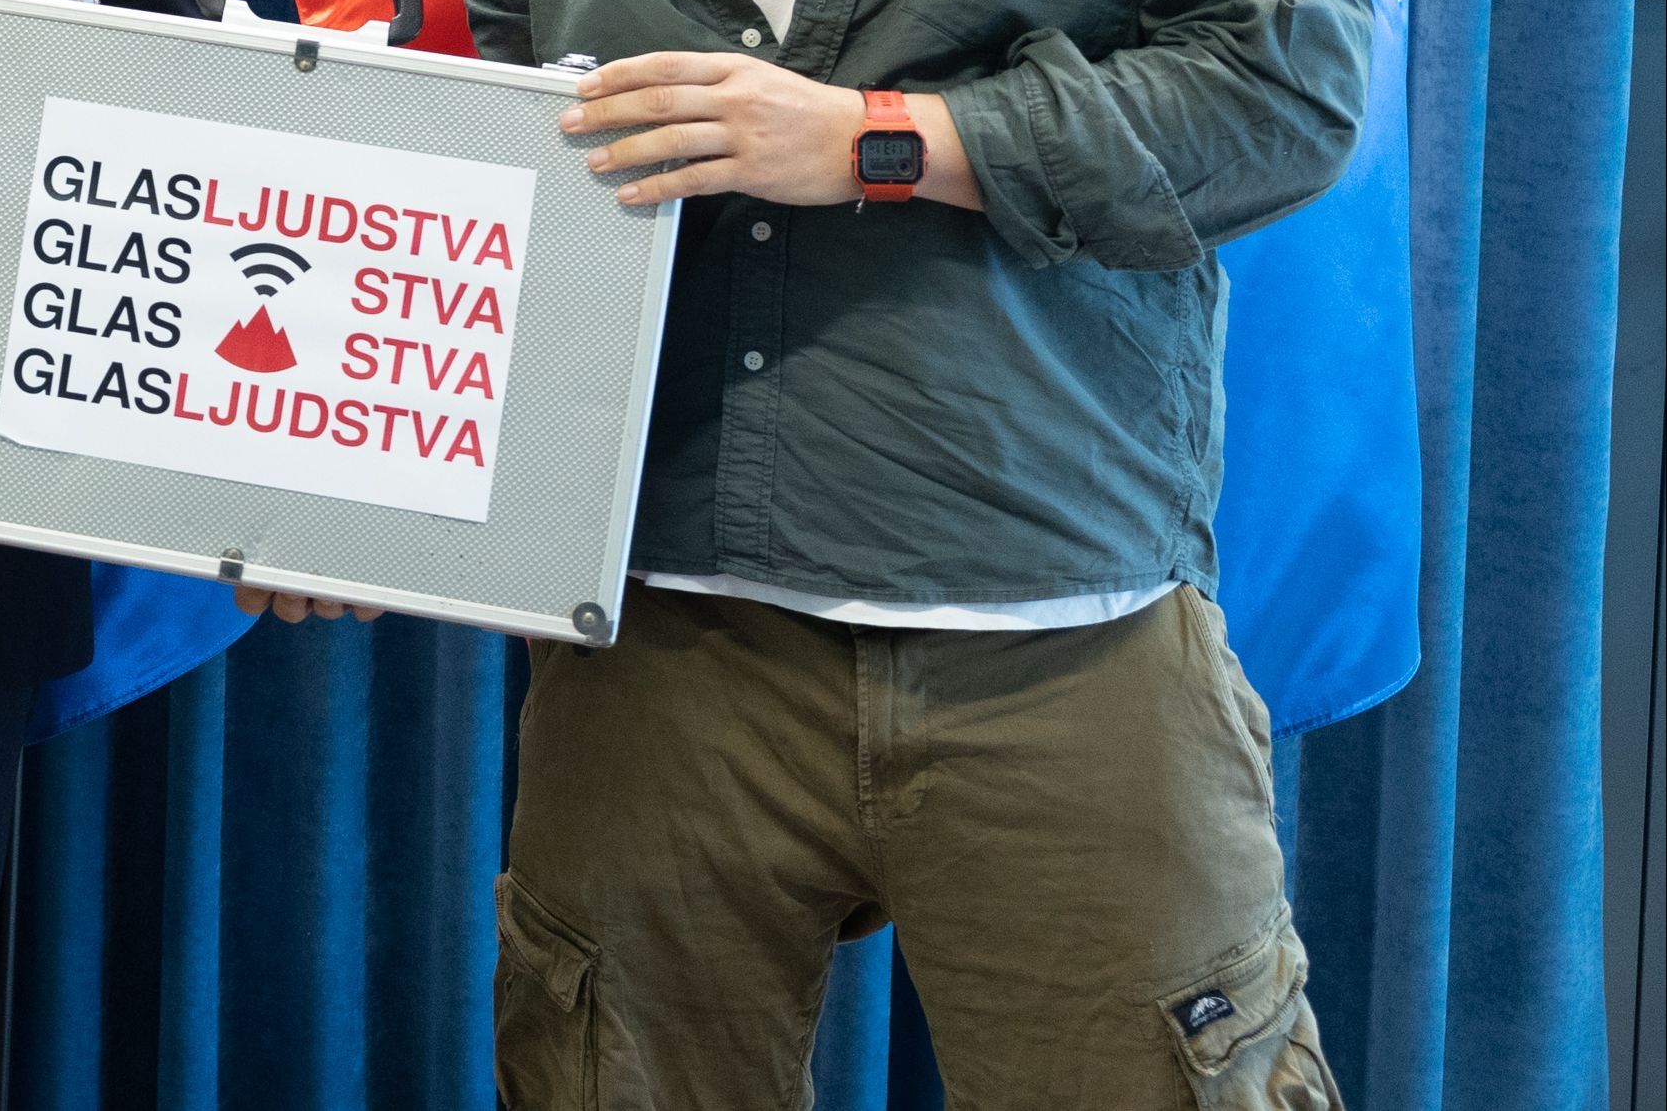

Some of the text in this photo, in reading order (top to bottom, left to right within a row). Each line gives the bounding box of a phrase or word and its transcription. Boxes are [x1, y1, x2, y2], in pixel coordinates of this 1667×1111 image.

[33, 218, 504, 334] GLAS STVA
[23, 282, 494, 400] GLAS STVA
